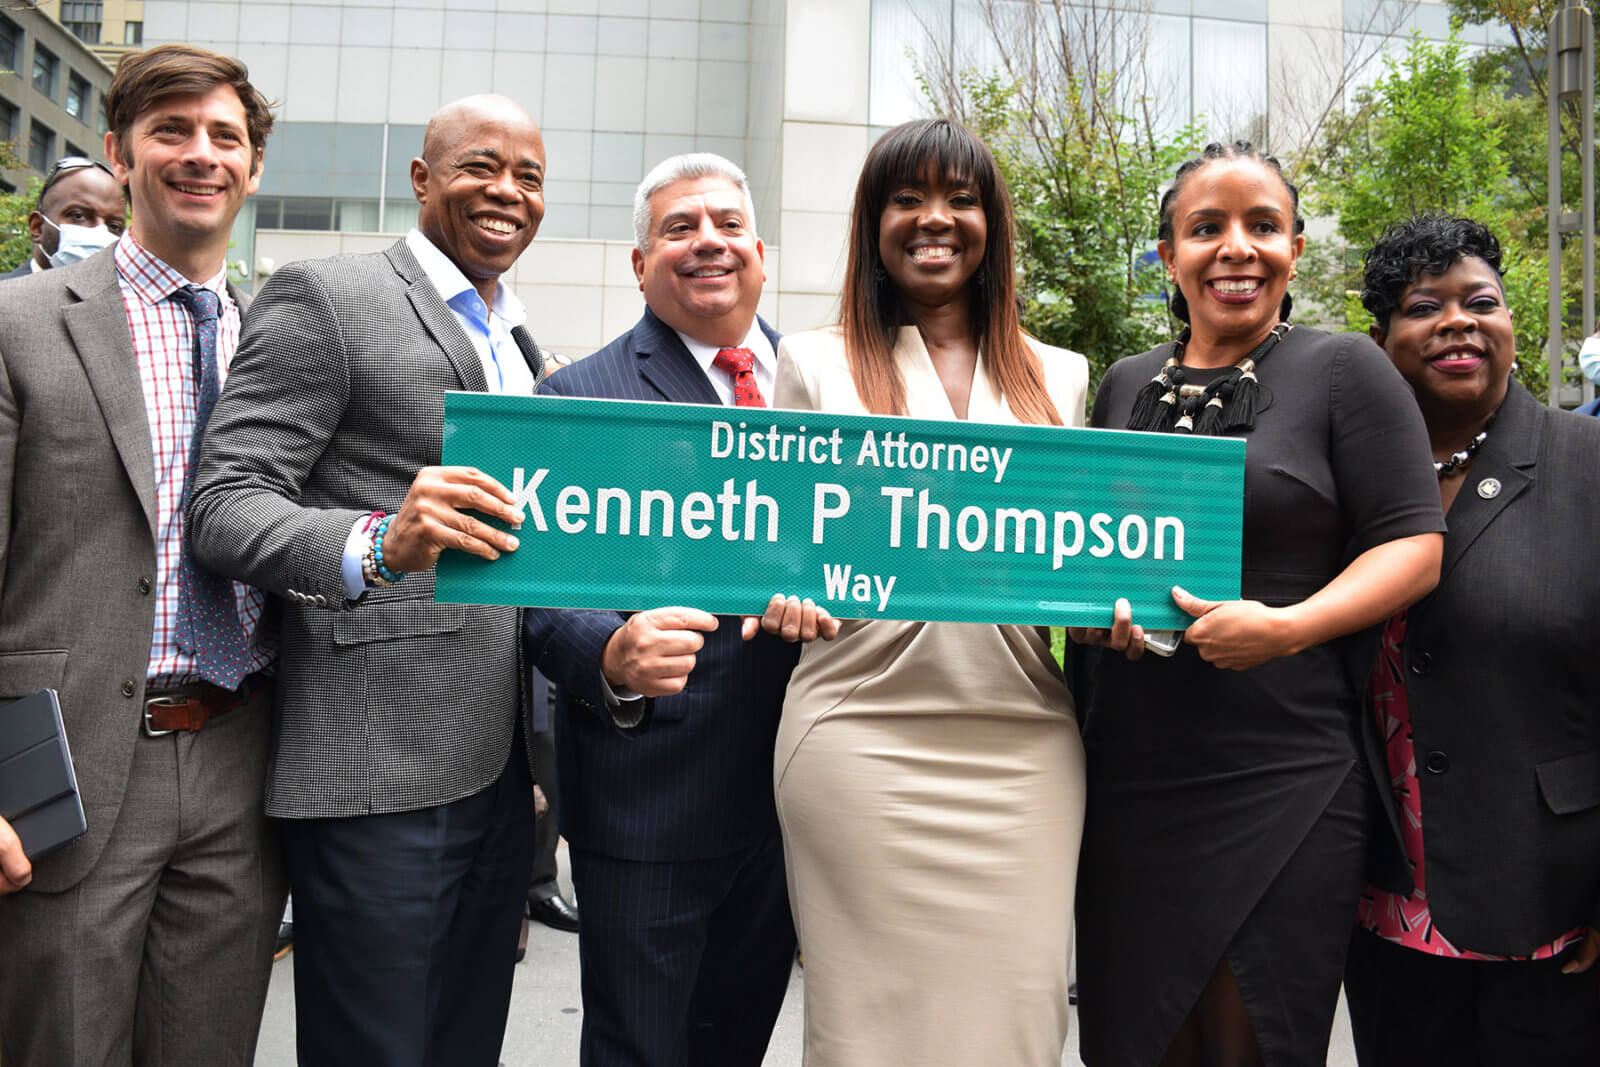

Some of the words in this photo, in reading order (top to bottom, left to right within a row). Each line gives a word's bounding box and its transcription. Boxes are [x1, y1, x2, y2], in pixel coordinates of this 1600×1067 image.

[710, 421, 843, 465] District
[856, 430, 1013, 483] Attorney
[510, 467, 779, 542] Kenneth
[812, 483, 851, 544] P
[880, 486, 1185, 571] Thompson
[823, 563, 897, 612] Way
